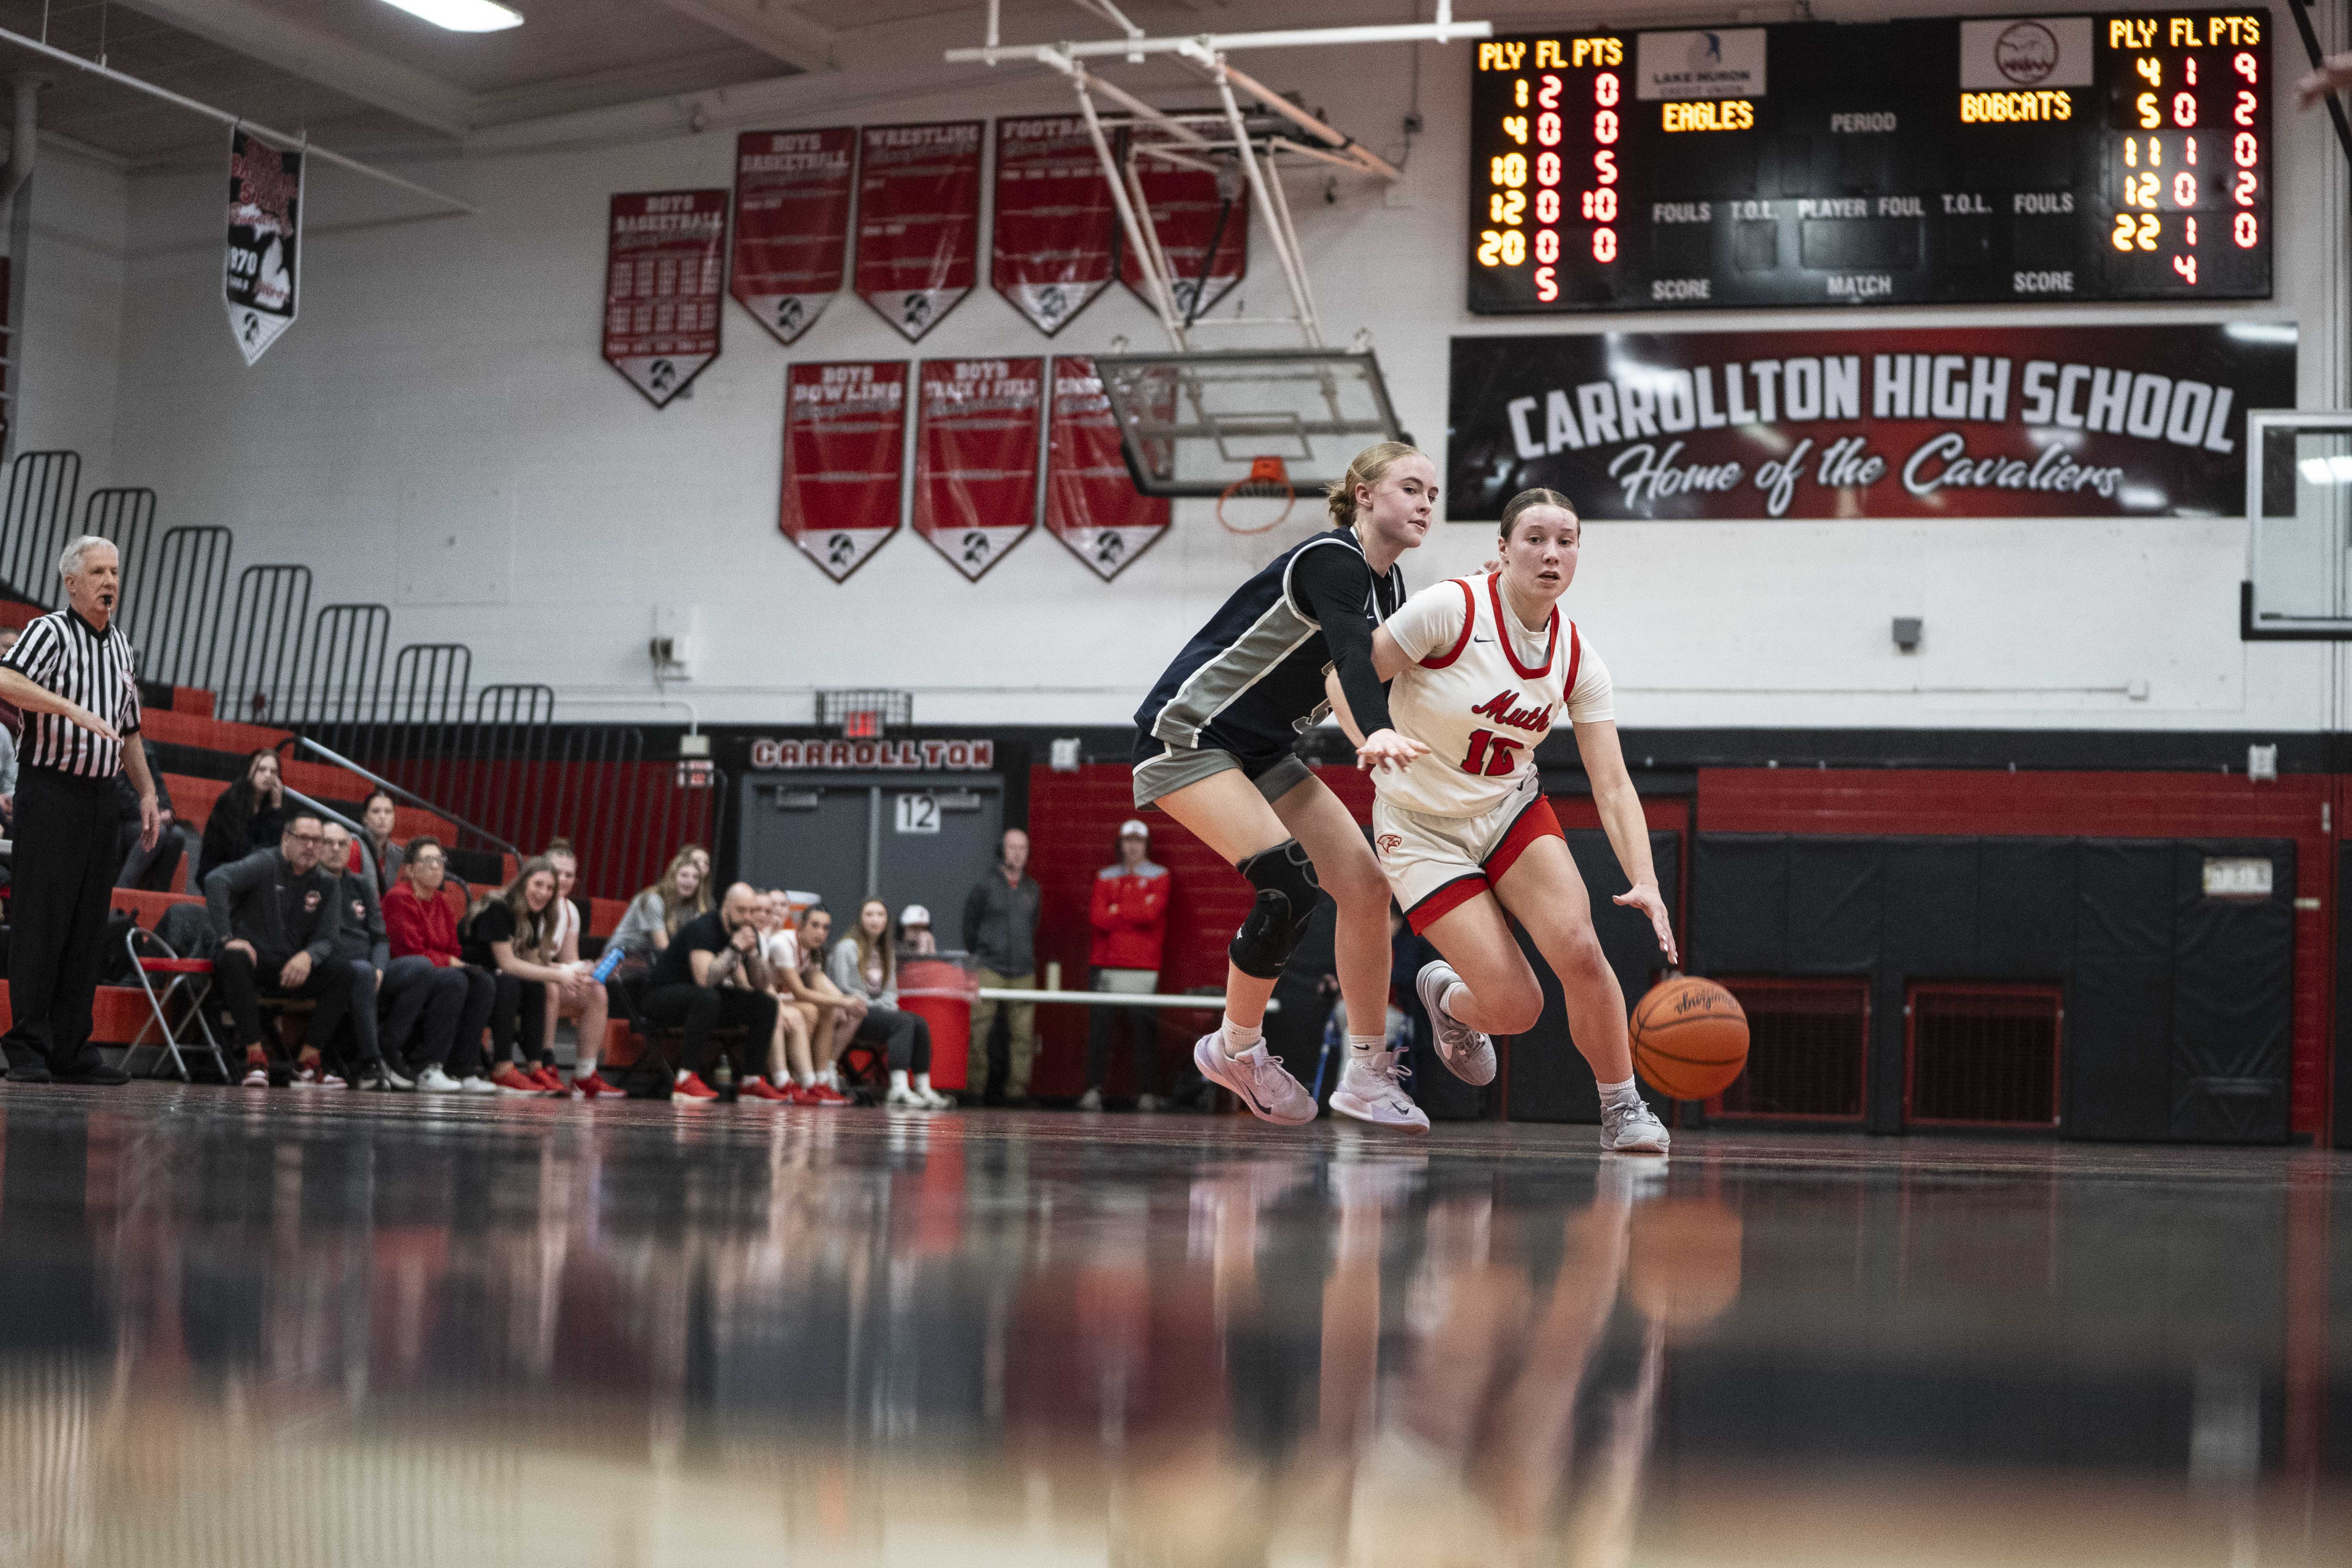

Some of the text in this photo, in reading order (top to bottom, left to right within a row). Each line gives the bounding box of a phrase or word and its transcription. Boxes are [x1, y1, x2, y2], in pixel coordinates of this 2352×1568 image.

[2110, 17, 2259, 48] PLY FL PTS
[1479, 38, 1622, 71] PLY FL PTS
[2136, 52, 2257, 87] 4 1 9
[1515, 73, 1619, 109] 1 2 0
[1652, 73, 1691, 84] LAKE
[1663, 101, 1753, 132] EAGLES
[1830, 112, 1897, 132] PERIOD
[1961, 91, 2071, 122] BOBCATS
[2136, 90, 2257, 129] 5 0 2
[1503, 110, 1619, 147] 4 0 0
[2124, 132, 2258, 169] 11 1 0
[1491, 150, 1618, 189] 10 0 5
[1490, 187, 1617, 225] 12 0 10
[1653, 201, 1711, 223] FOULS
[1798, 198, 1867, 218] PLAYER
[1878, 197, 1926, 216] FOUL
[1941, 194, 1993, 214] T.O.L.
[2013, 193, 2074, 214] FOULS
[2124, 170, 2258, 211] 12 0 2
[616, 212, 723, 233] BASKETBALL
[2112, 212, 2258, 252] 22 1 0
[1477, 227, 1617, 267] 20 0 0
[1534, 266, 1558, 302] 5
[1652, 271, 2074, 299] SCORE MATCH SCORE
[2173, 255, 2197, 285] 4
[794, 383, 902, 402] BOWLING
[1507, 353, 2236, 460] CARROLLTON HIGH SCHOOL
[1608, 432, 2124, 517] Home of the Cavaliers
[1472, 689, 1553, 733] Muth
[751, 739, 994, 769] CARROLLTON
[903, 794, 935, 829] 12
